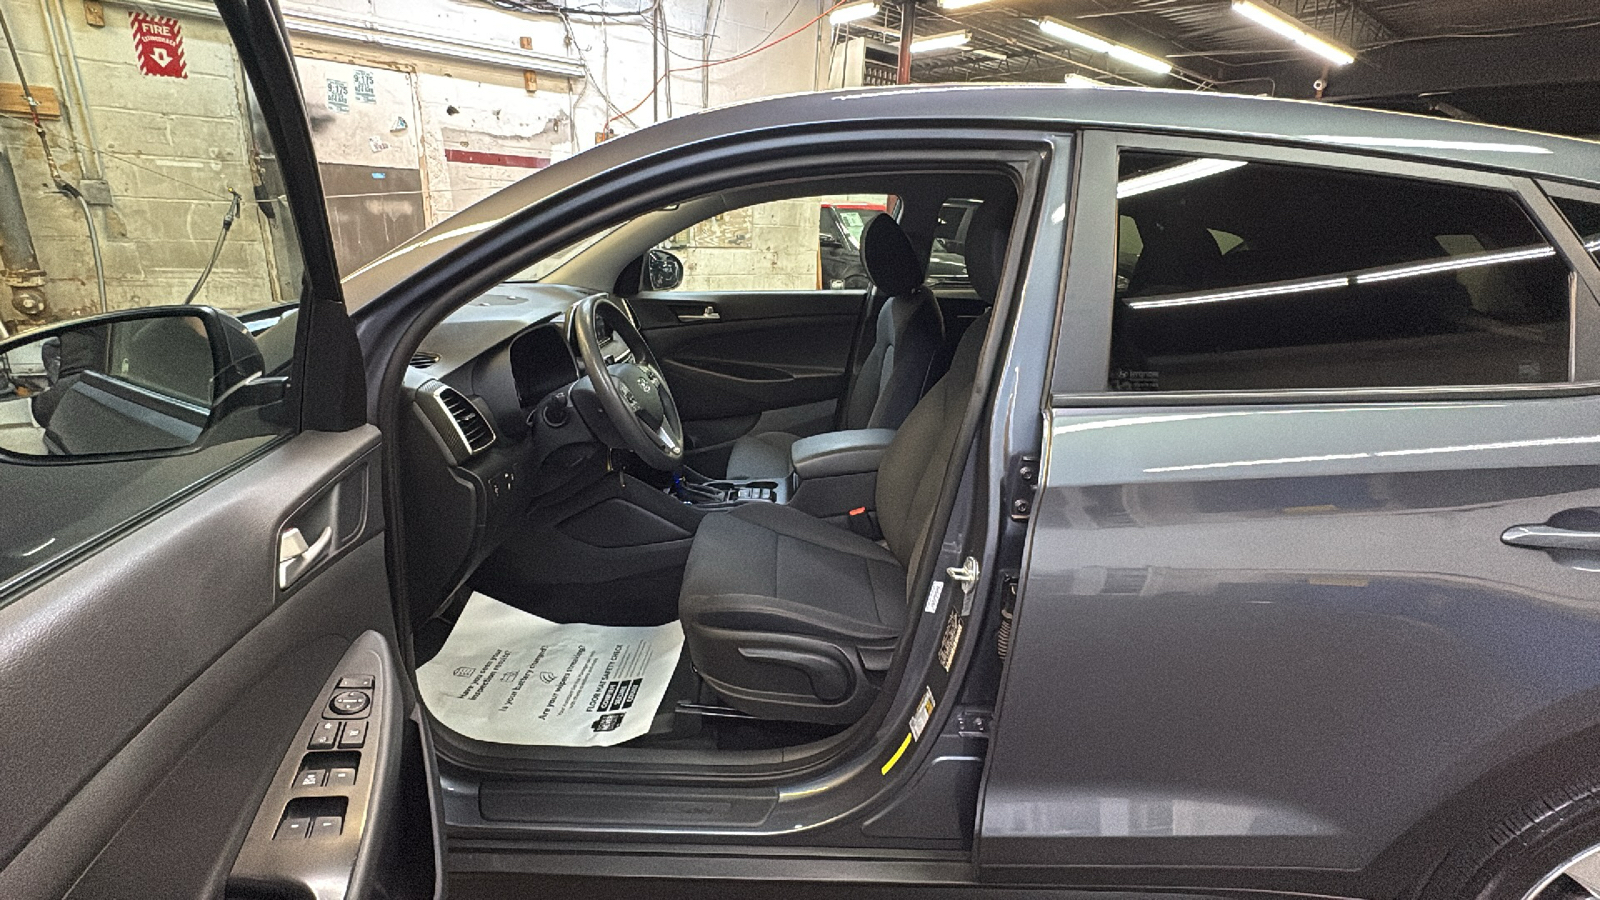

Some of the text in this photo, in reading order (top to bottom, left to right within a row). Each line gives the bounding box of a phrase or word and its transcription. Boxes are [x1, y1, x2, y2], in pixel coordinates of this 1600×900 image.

[141, 22, 172, 36] FIRE
[457, 685, 473, 698] Have
[471, 675, 483, 684] you
[490, 649, 502, 660] your
[468, 672, 497, 700] inspection
[505, 691, 517, 705] your
[512, 670, 533, 690] battery
[586, 693, 600, 712] FLOOR
[596, 681, 606, 692] MAT
[602, 662, 615, 680] SAFETY
[611, 645, 623, 660] CHECK
[538, 708, 550, 719] Are
[547, 693, 558, 707] your
[555, 673, 570, 691] wipers
